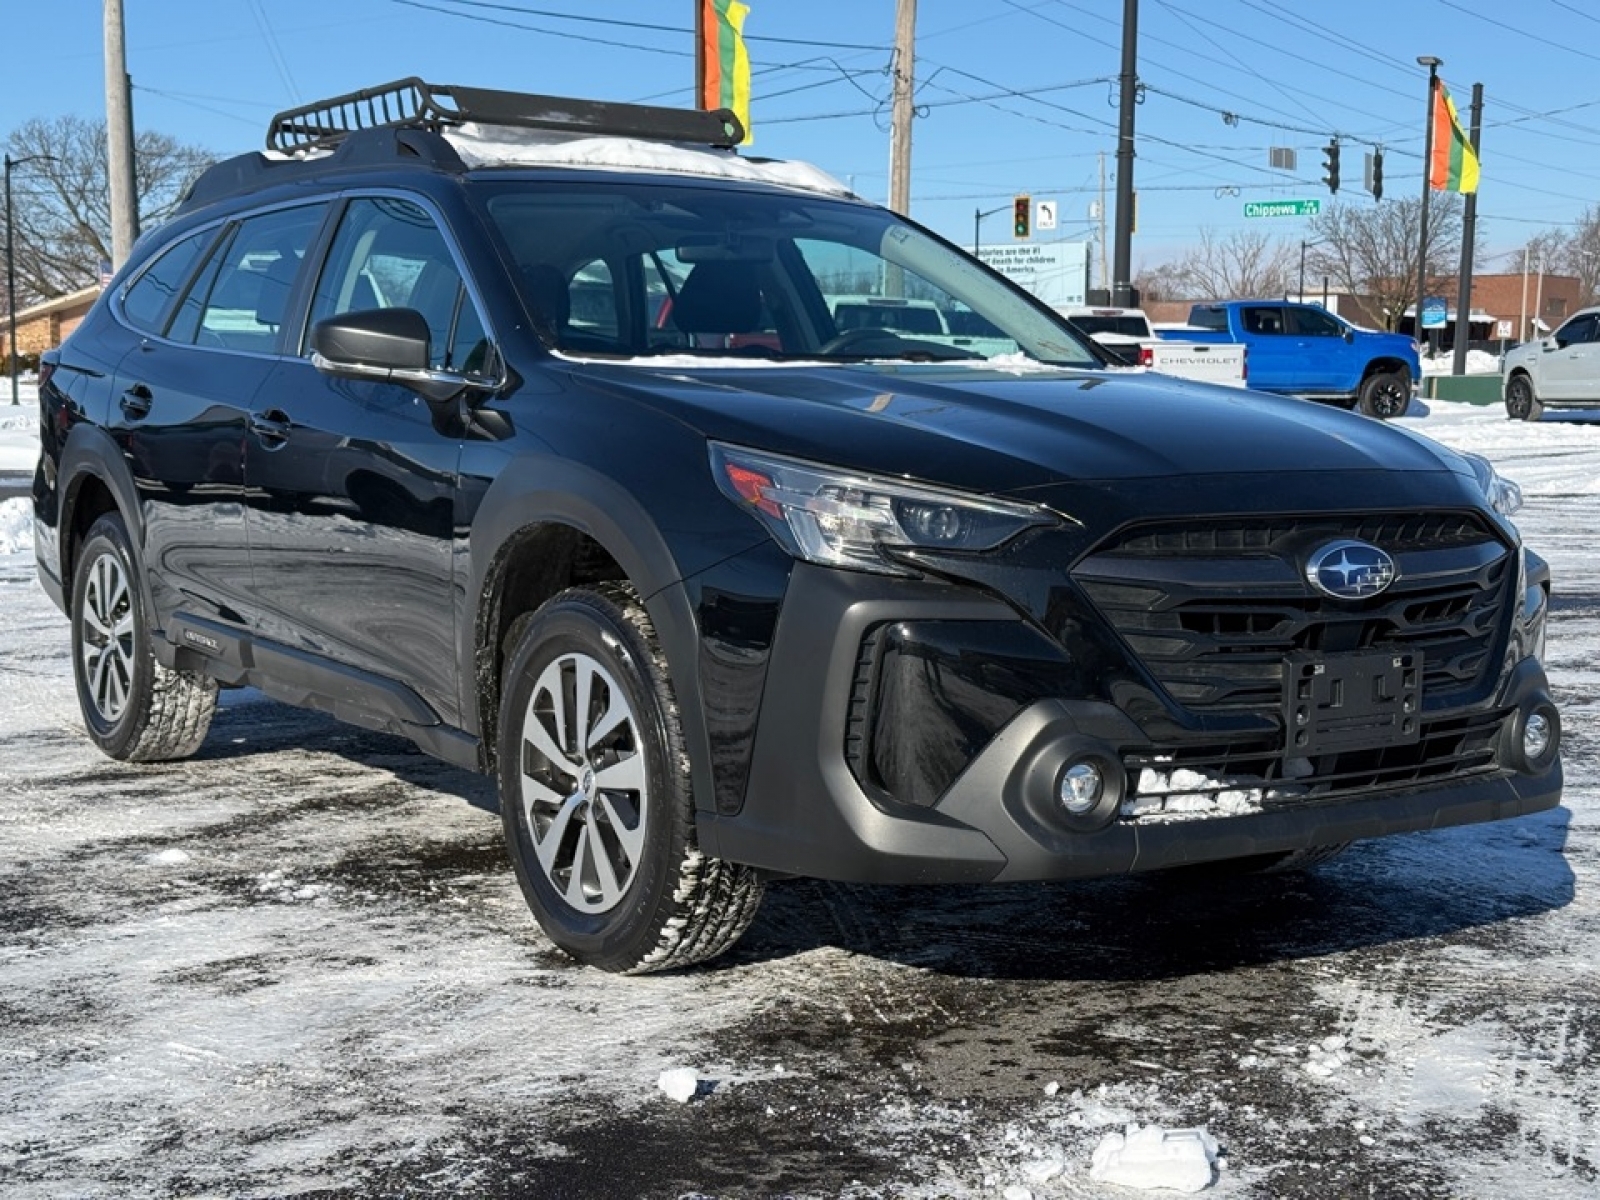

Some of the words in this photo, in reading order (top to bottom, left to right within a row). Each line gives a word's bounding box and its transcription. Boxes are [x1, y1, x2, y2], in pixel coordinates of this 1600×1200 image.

[976, 247, 1004, 258] njuries
[1005, 248, 1017, 256] are
[1018, 247, 1031, 255] the
[1032, 246, 1041, 255] #1
[991, 256, 1012, 265] death
[1014, 256, 1024, 264] for
[1026, 256, 1056, 265] children
[1160, 357, 1239, 365] CHEVROLET
